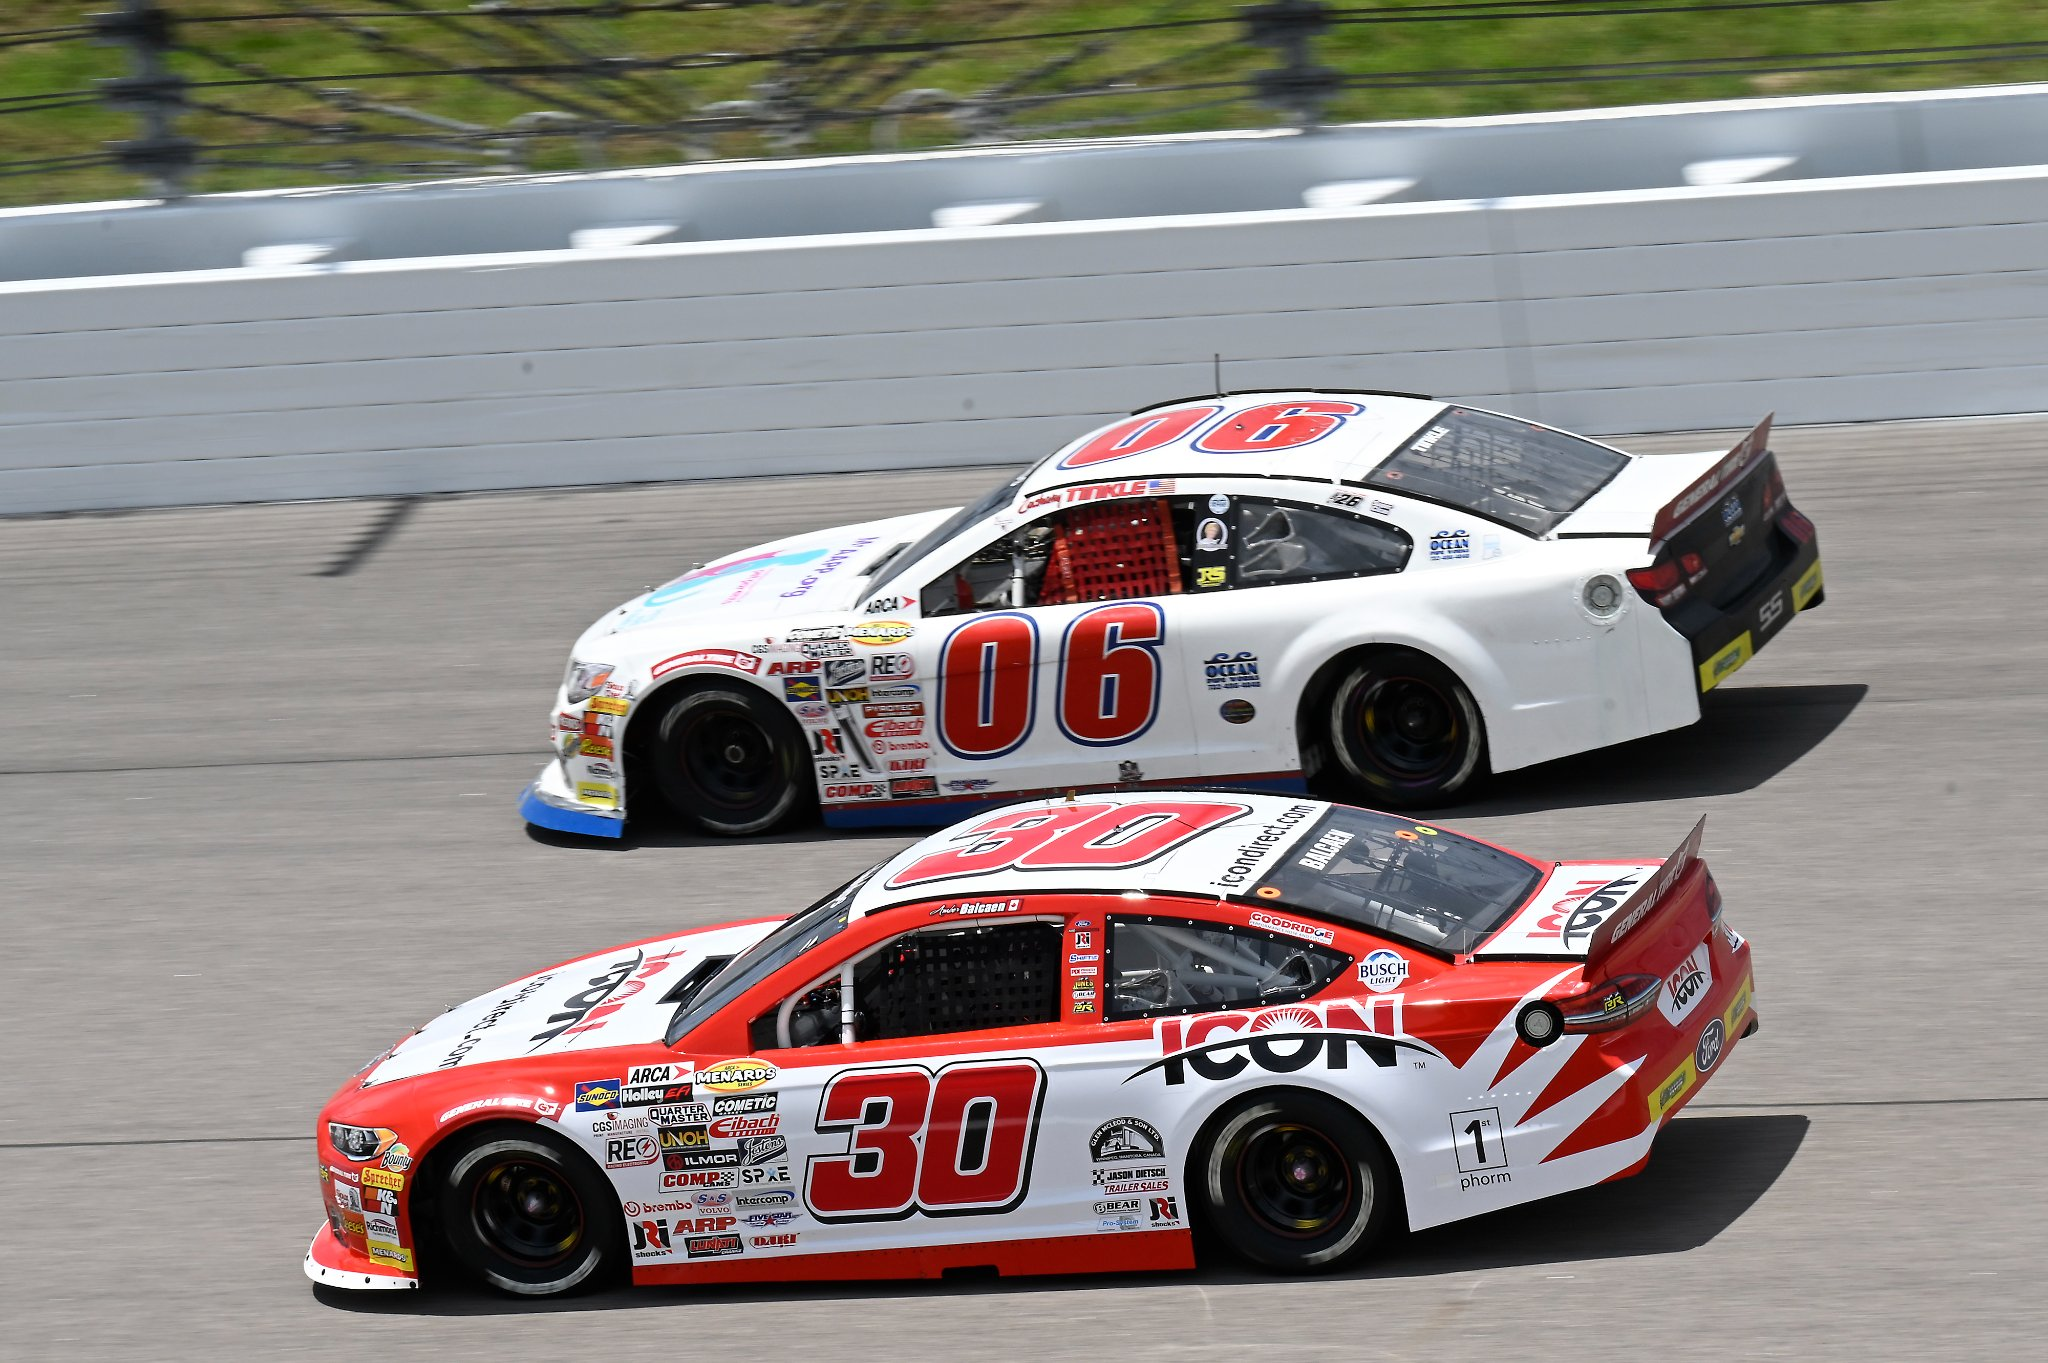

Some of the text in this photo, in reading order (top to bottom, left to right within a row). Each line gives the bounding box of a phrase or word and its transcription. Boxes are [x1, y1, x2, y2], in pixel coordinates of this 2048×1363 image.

[1056, 400, 1366, 470] 06
[1067, 481, 1147, 502] TINKLE
[864, 597, 898, 614] ARCA
[767, 660, 822, 675] ARP
[1206, 663, 1258, 677] OCEAN
[936, 602, 1165, 761] 06
[889, 741, 930, 750] brembo
[826, 784, 874, 798] COMP
[884, 801, 1253, 891] 30
[1210, 804, 1318, 888] icondirect.com
[1299, 829, 1355, 871] BALCAEN
[959, 902, 1006, 915] Balcaen
[1252, 913, 1333, 940] GOODRIDGE
[1359, 961, 1407, 980] BUSCH
[1370, 975, 1397, 985] LIGHT
[1158, 995, 1402, 1086] ICON
[1700, 1024, 1721, 1067] Ford
[630, 1066, 670, 1084] ARCA
[696, 1067, 777, 1085] MENARDS
[579, 1091, 619, 1103] SUNOCO
[623, 1088, 664, 1103] Holley
[650, 1105, 704, 1120] QUARTER
[715, 1096, 776, 1113] COMETIC
[661, 1113, 709, 1125] MASTER
[709, 1114, 780, 1138] Eibach
[659, 1130, 709, 1148] UNOH
[802, 1057, 1048, 1225] 30
[1091, 1129, 1103, 1147] GLEN
[1102, 1119, 1127, 1133] MCLEOD
[1134, 1120, 1148, 1130] SON
[382, 1151, 412, 1170] Bounty
[685, 1155, 738, 1166] ILMOR
[363, 1169, 402, 1189] Sprecher
[664, 1171, 720, 1187] COMP
[1107, 1168, 1166, 1181] JASON DIETSCH
[1460, 1172, 1512, 1191] phorm
[1104, 1180, 1169, 1193] TRAILER SALES
[643, 1200, 693, 1213] brembo
[736, 1195, 789, 1206] Intercomp
[1106, 1200, 1139, 1210] BEAR
[673, 1216, 737, 1236] ARP
[1102, 1218, 1139, 1227] Pro-System
[690, 1237, 737, 1252] LUNATI
[372, 1246, 406, 1263] MENARDS
[635, 1250, 667, 1258] shocks
